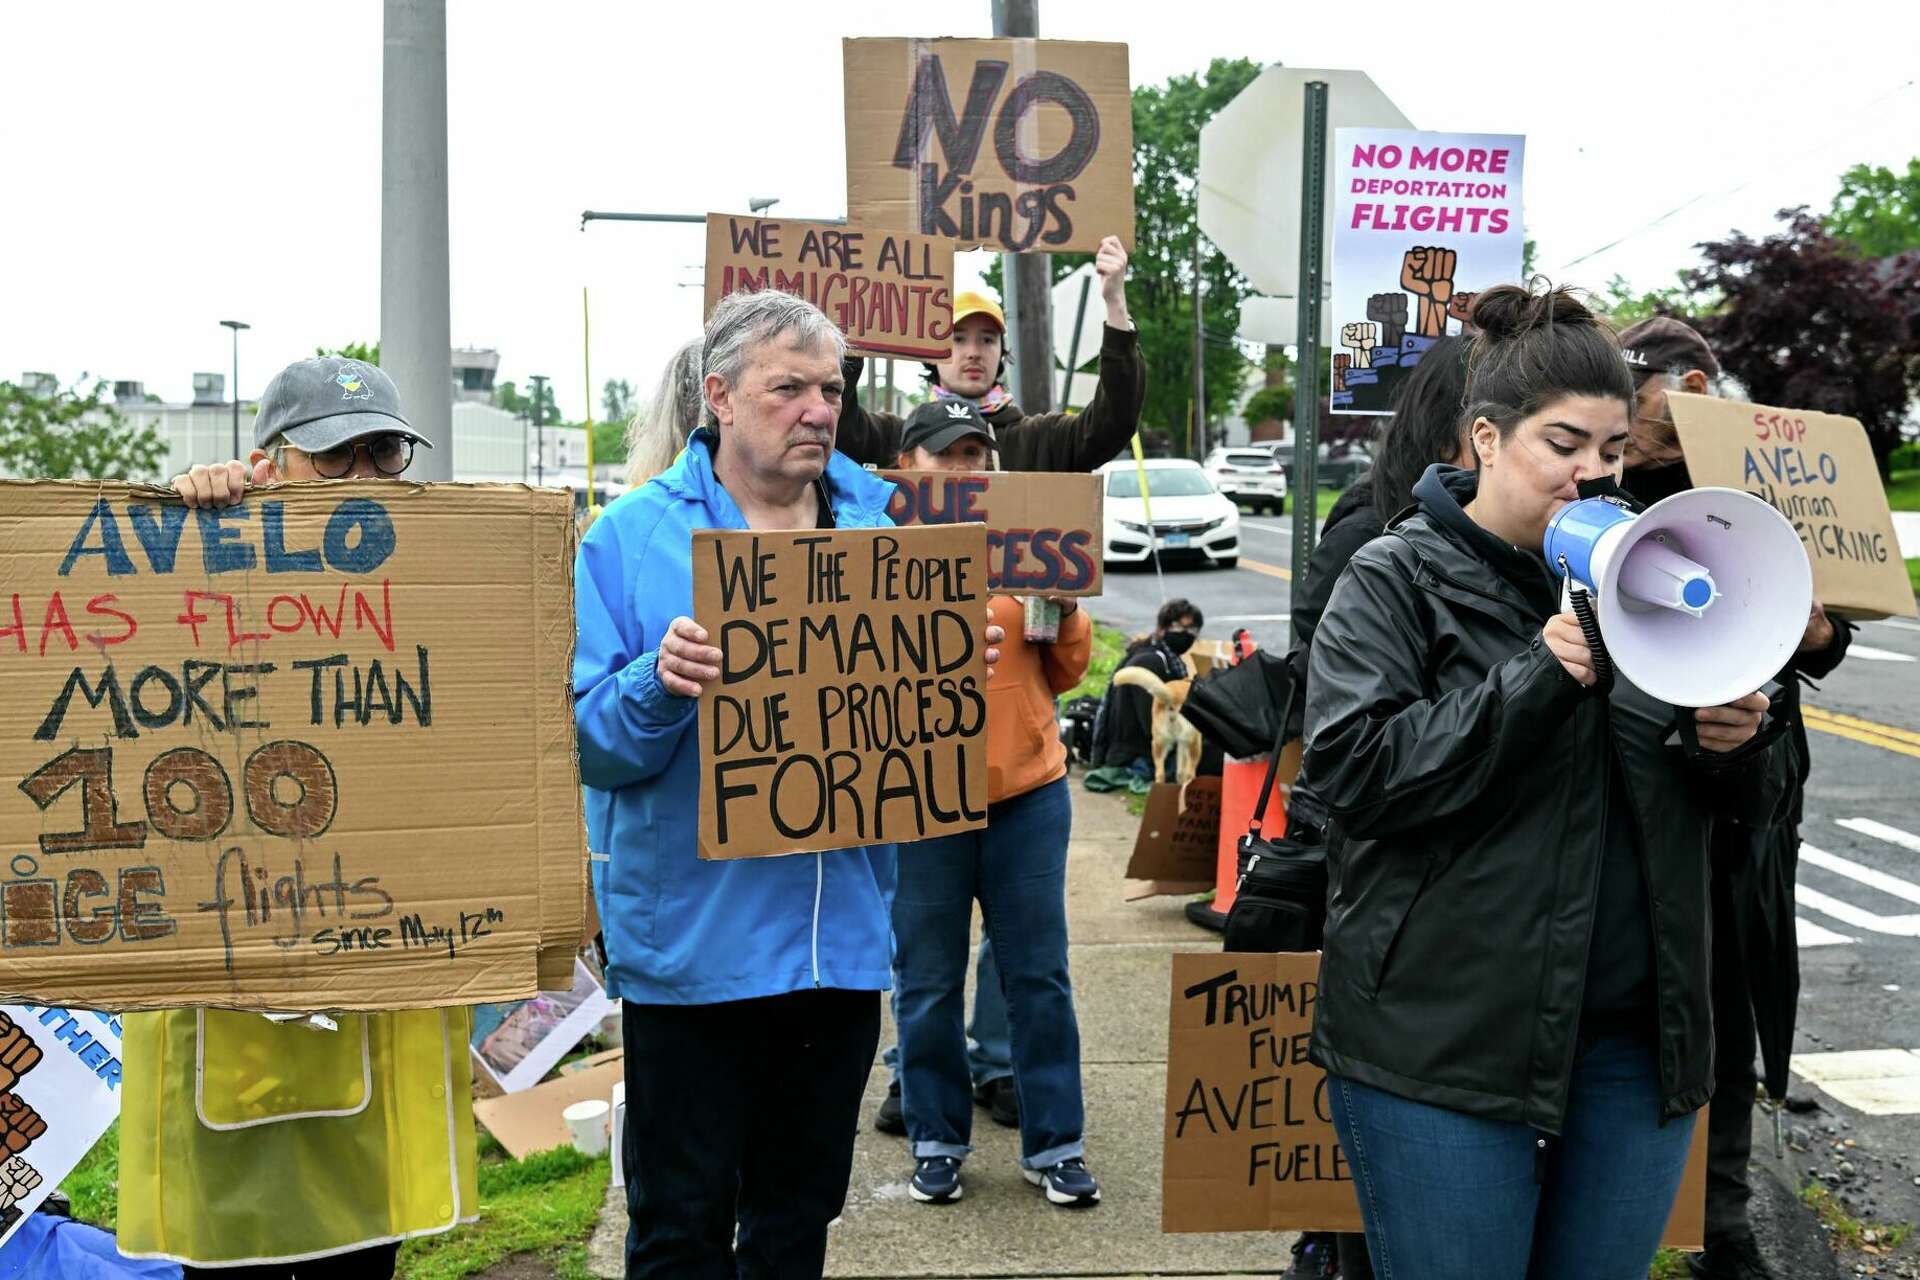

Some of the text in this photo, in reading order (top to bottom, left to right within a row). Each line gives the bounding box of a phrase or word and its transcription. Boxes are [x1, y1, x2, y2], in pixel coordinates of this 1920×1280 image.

[892, 54, 1099, 185] NO
[1351, 144, 1509, 174] NO MORE
[1351, 178, 1506, 199] DEPORTATION
[729, 218, 944, 281] WE ARE ALL
[1351, 203, 1509, 234] FLIGHTS
[1754, 413, 1806, 442] STOP
[883, 474, 989, 525] DUE
[1744, 446, 1836, 486] AVELO
[58, 497, 397, 576] AVELO
[715, 535, 976, 612] WE THE PEOPLE
[0, 579, 395, 657] HAS FLOWN
[720, 610, 974, 684] DEMAND
[33, 645, 431, 740] MORE THAN
[713, 675, 986, 756] DUE PROCESS
[18, 740, 338, 853] 100
[715, 744, 986, 844] FOR ALL
[197, 847, 393, 974] flights
[312, 924, 392, 956] since
[399, 913, 456, 960] May
[1184, 969, 1319, 1026] TRUMP
[38, 1006, 121, 1091] THER
